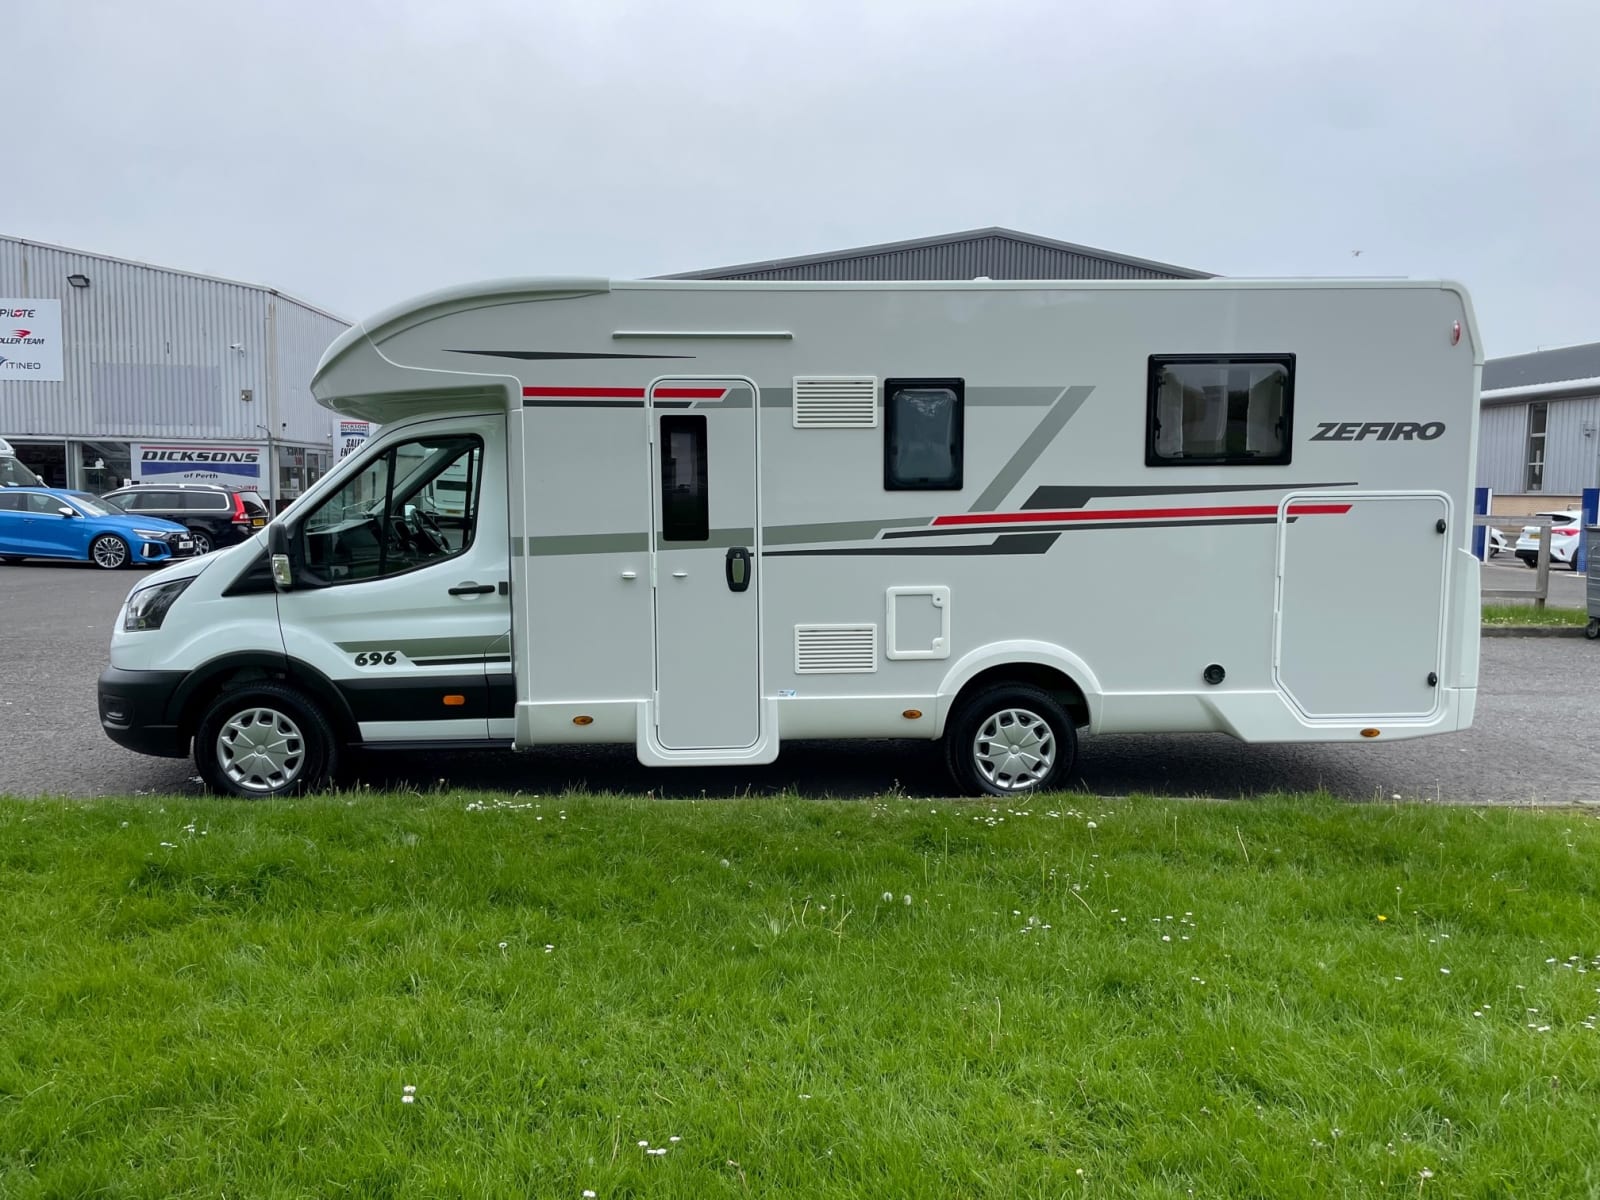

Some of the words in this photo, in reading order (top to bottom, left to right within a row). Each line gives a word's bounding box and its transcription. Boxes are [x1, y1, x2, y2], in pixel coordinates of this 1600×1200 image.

[1308, 421, 1446, 441] ZEFIRO
[141, 451, 260, 463] DICKSONS
[355, 651, 397, 667] 696
